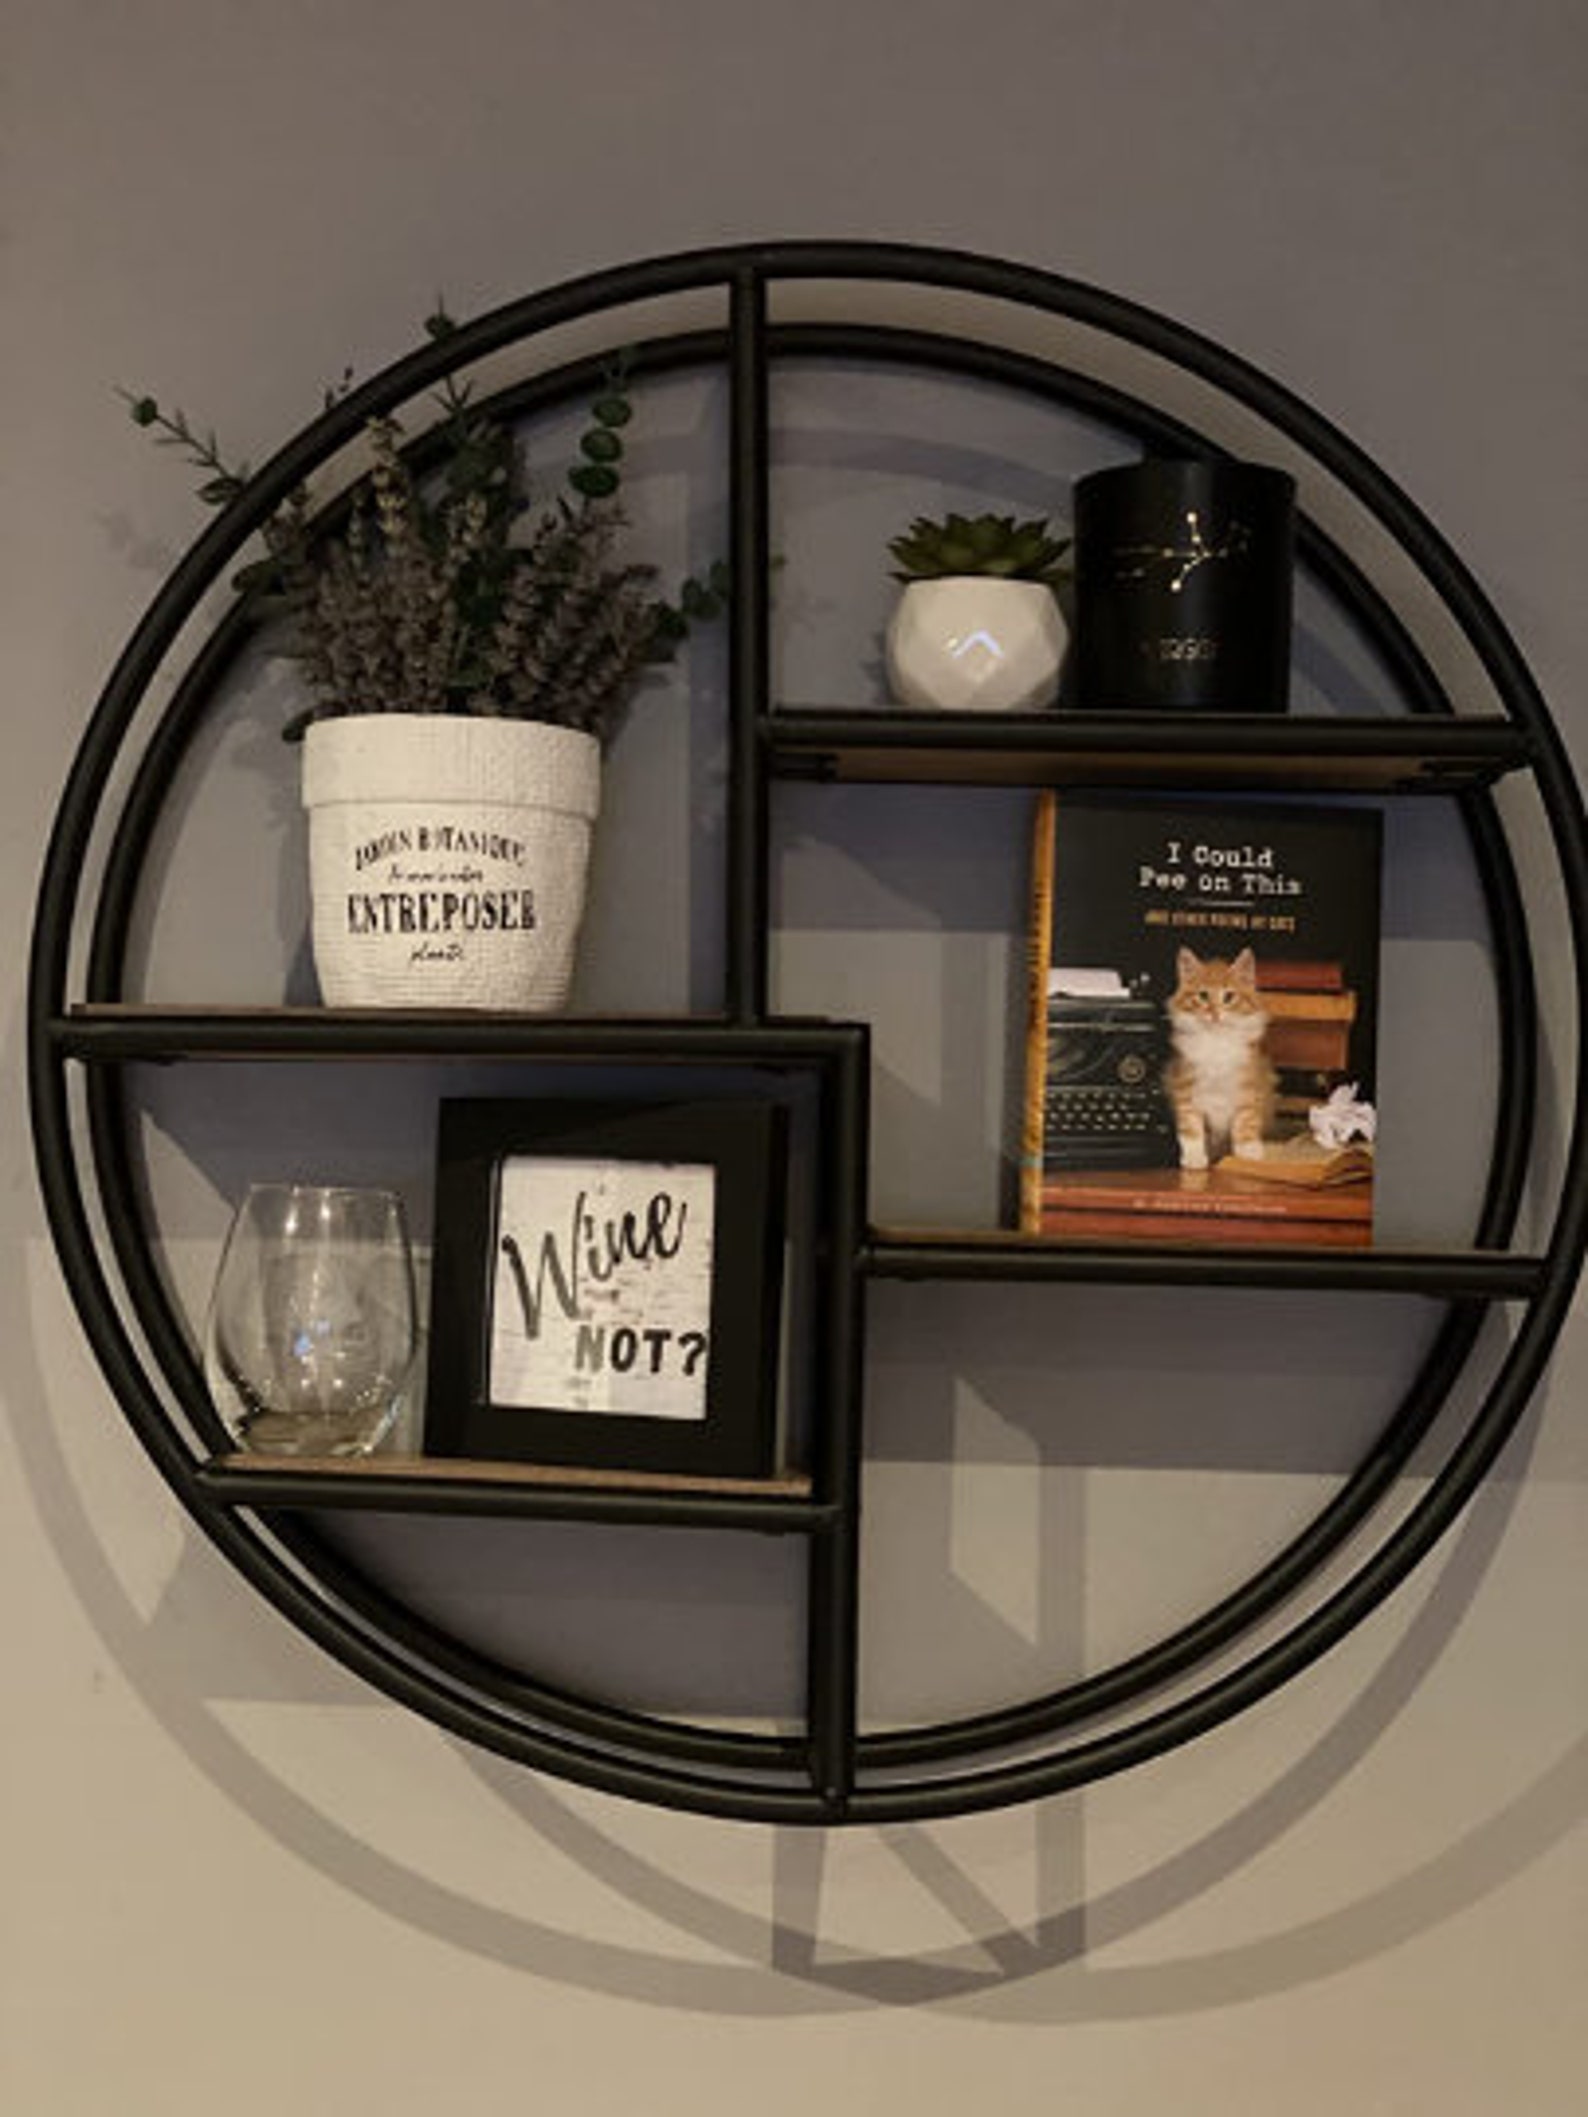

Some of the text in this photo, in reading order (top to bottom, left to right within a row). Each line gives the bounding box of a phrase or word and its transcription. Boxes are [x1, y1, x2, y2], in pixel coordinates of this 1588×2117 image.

[1167, 841, 1273, 868] I Could
[1139, 866, 1187, 890] Pee
[1241, 873, 1302, 895] This
[501, 1191, 688, 1341] Wine
[574, 1324, 707, 1376] NOT?
